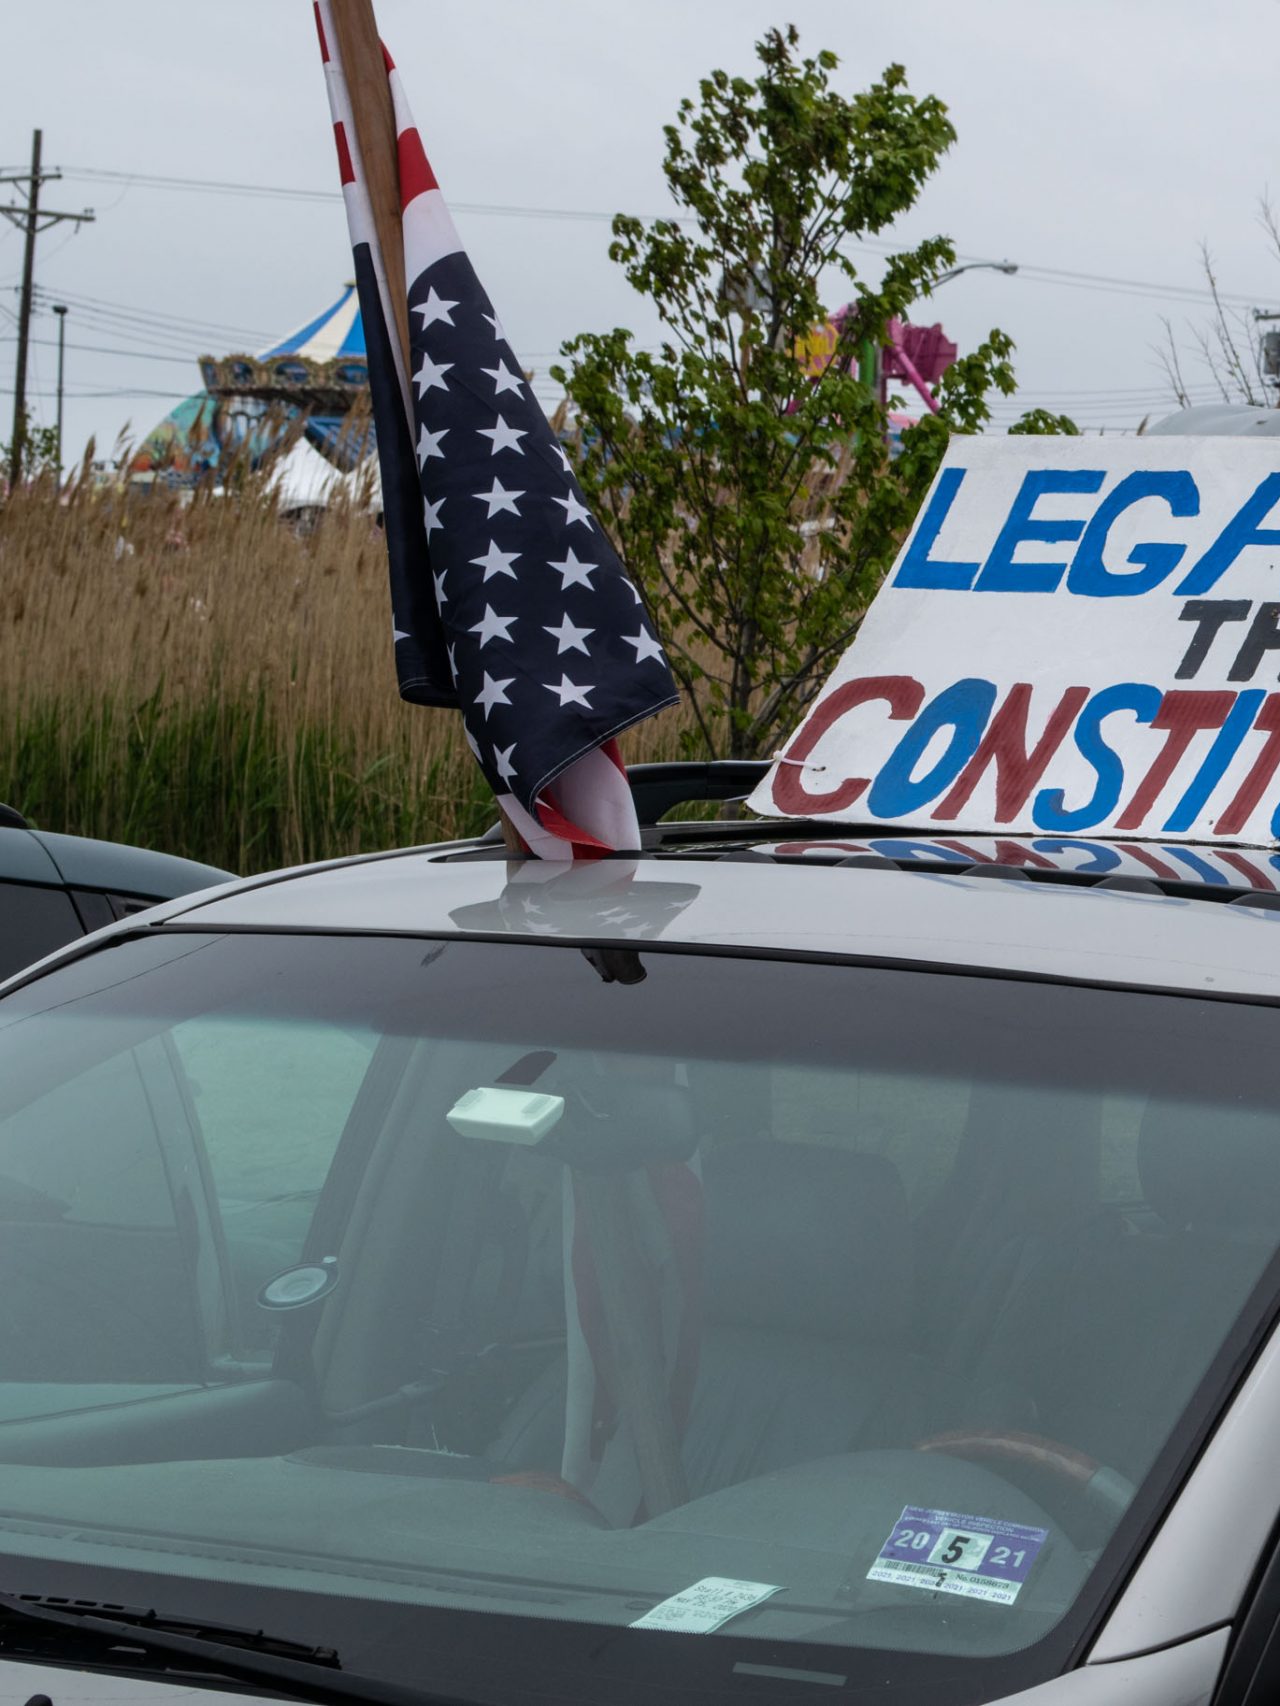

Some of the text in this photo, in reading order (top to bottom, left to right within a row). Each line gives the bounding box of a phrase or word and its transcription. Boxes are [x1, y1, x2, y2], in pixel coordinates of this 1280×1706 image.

[894, 1529, 930, 1550] 20
[941, 1535, 971, 1564] 5
[990, 1546, 1026, 1568] 21
